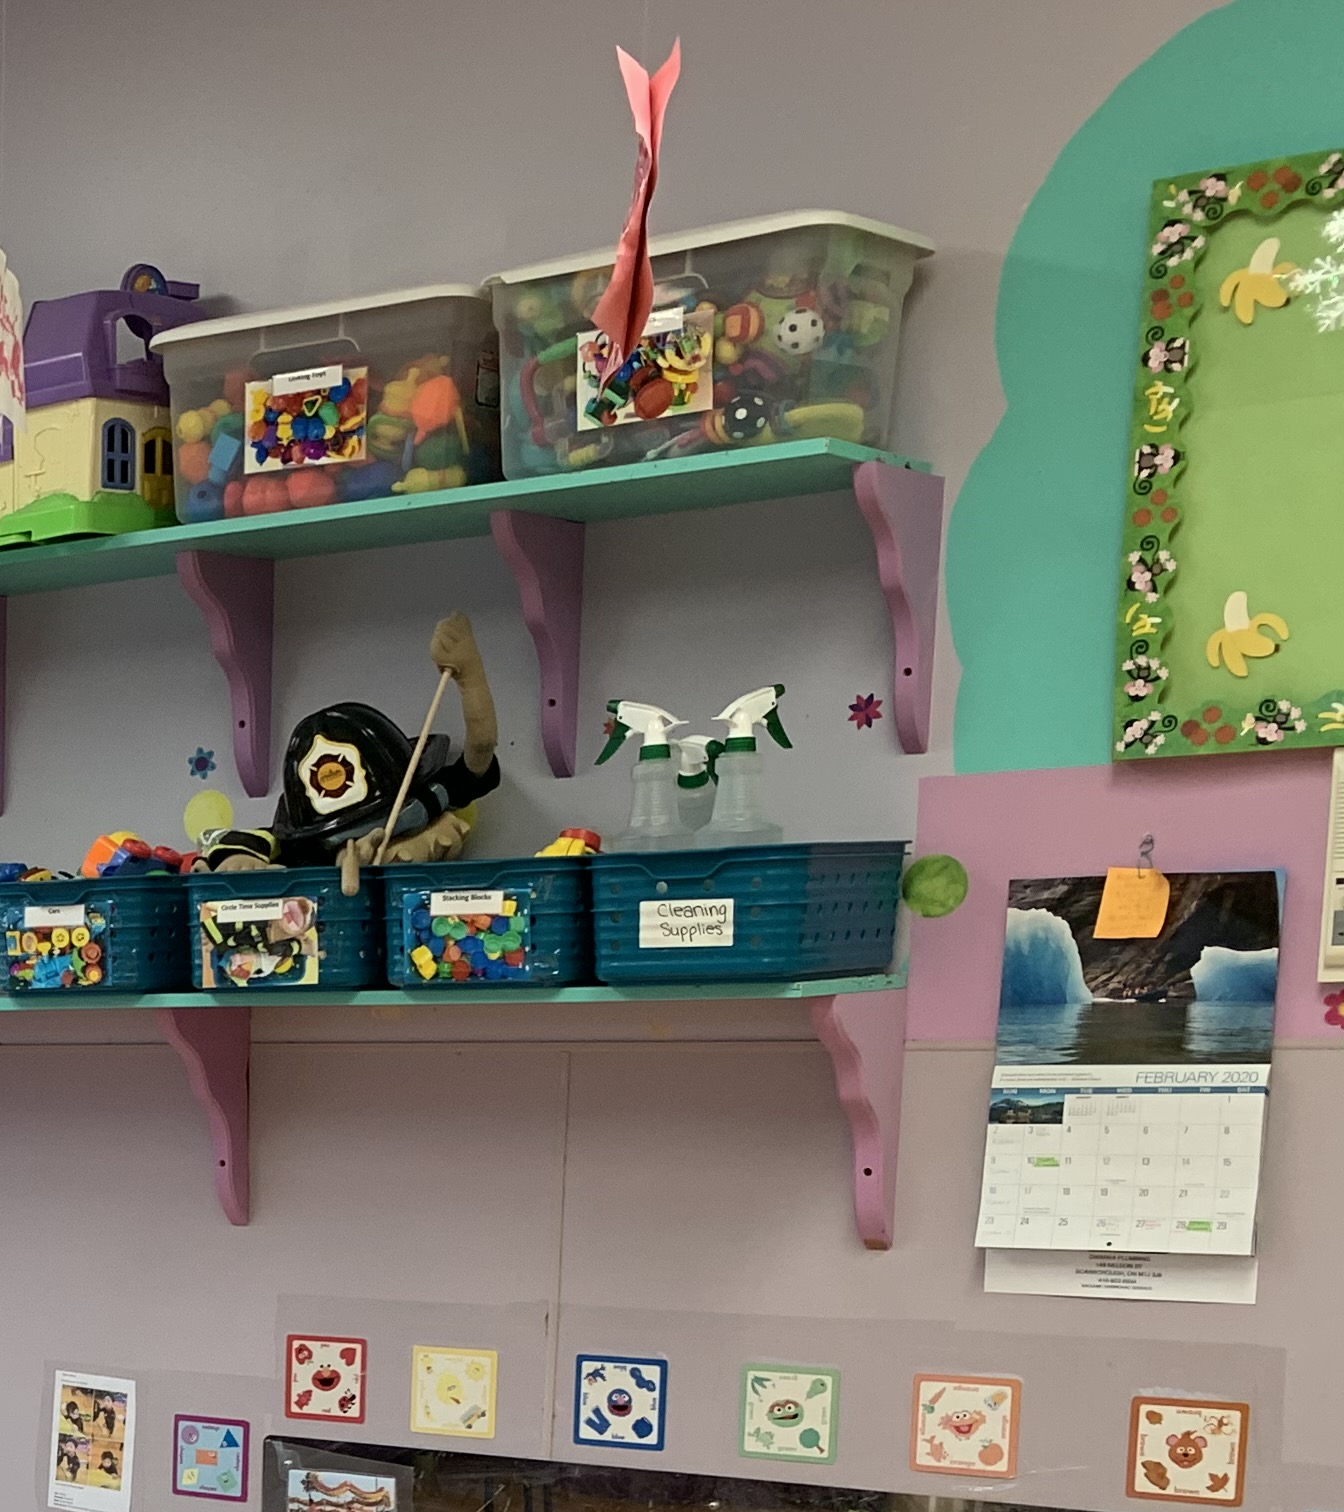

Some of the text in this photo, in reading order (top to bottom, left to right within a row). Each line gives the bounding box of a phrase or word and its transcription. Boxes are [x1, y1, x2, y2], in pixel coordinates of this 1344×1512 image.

[442, 893, 492, 902] Stacking Blocks
[657, 903, 727, 924] Cleaning
[660, 922, 723, 942] Supplies
[1135, 1071, 1259, 1085] FEBRUARY 2020
